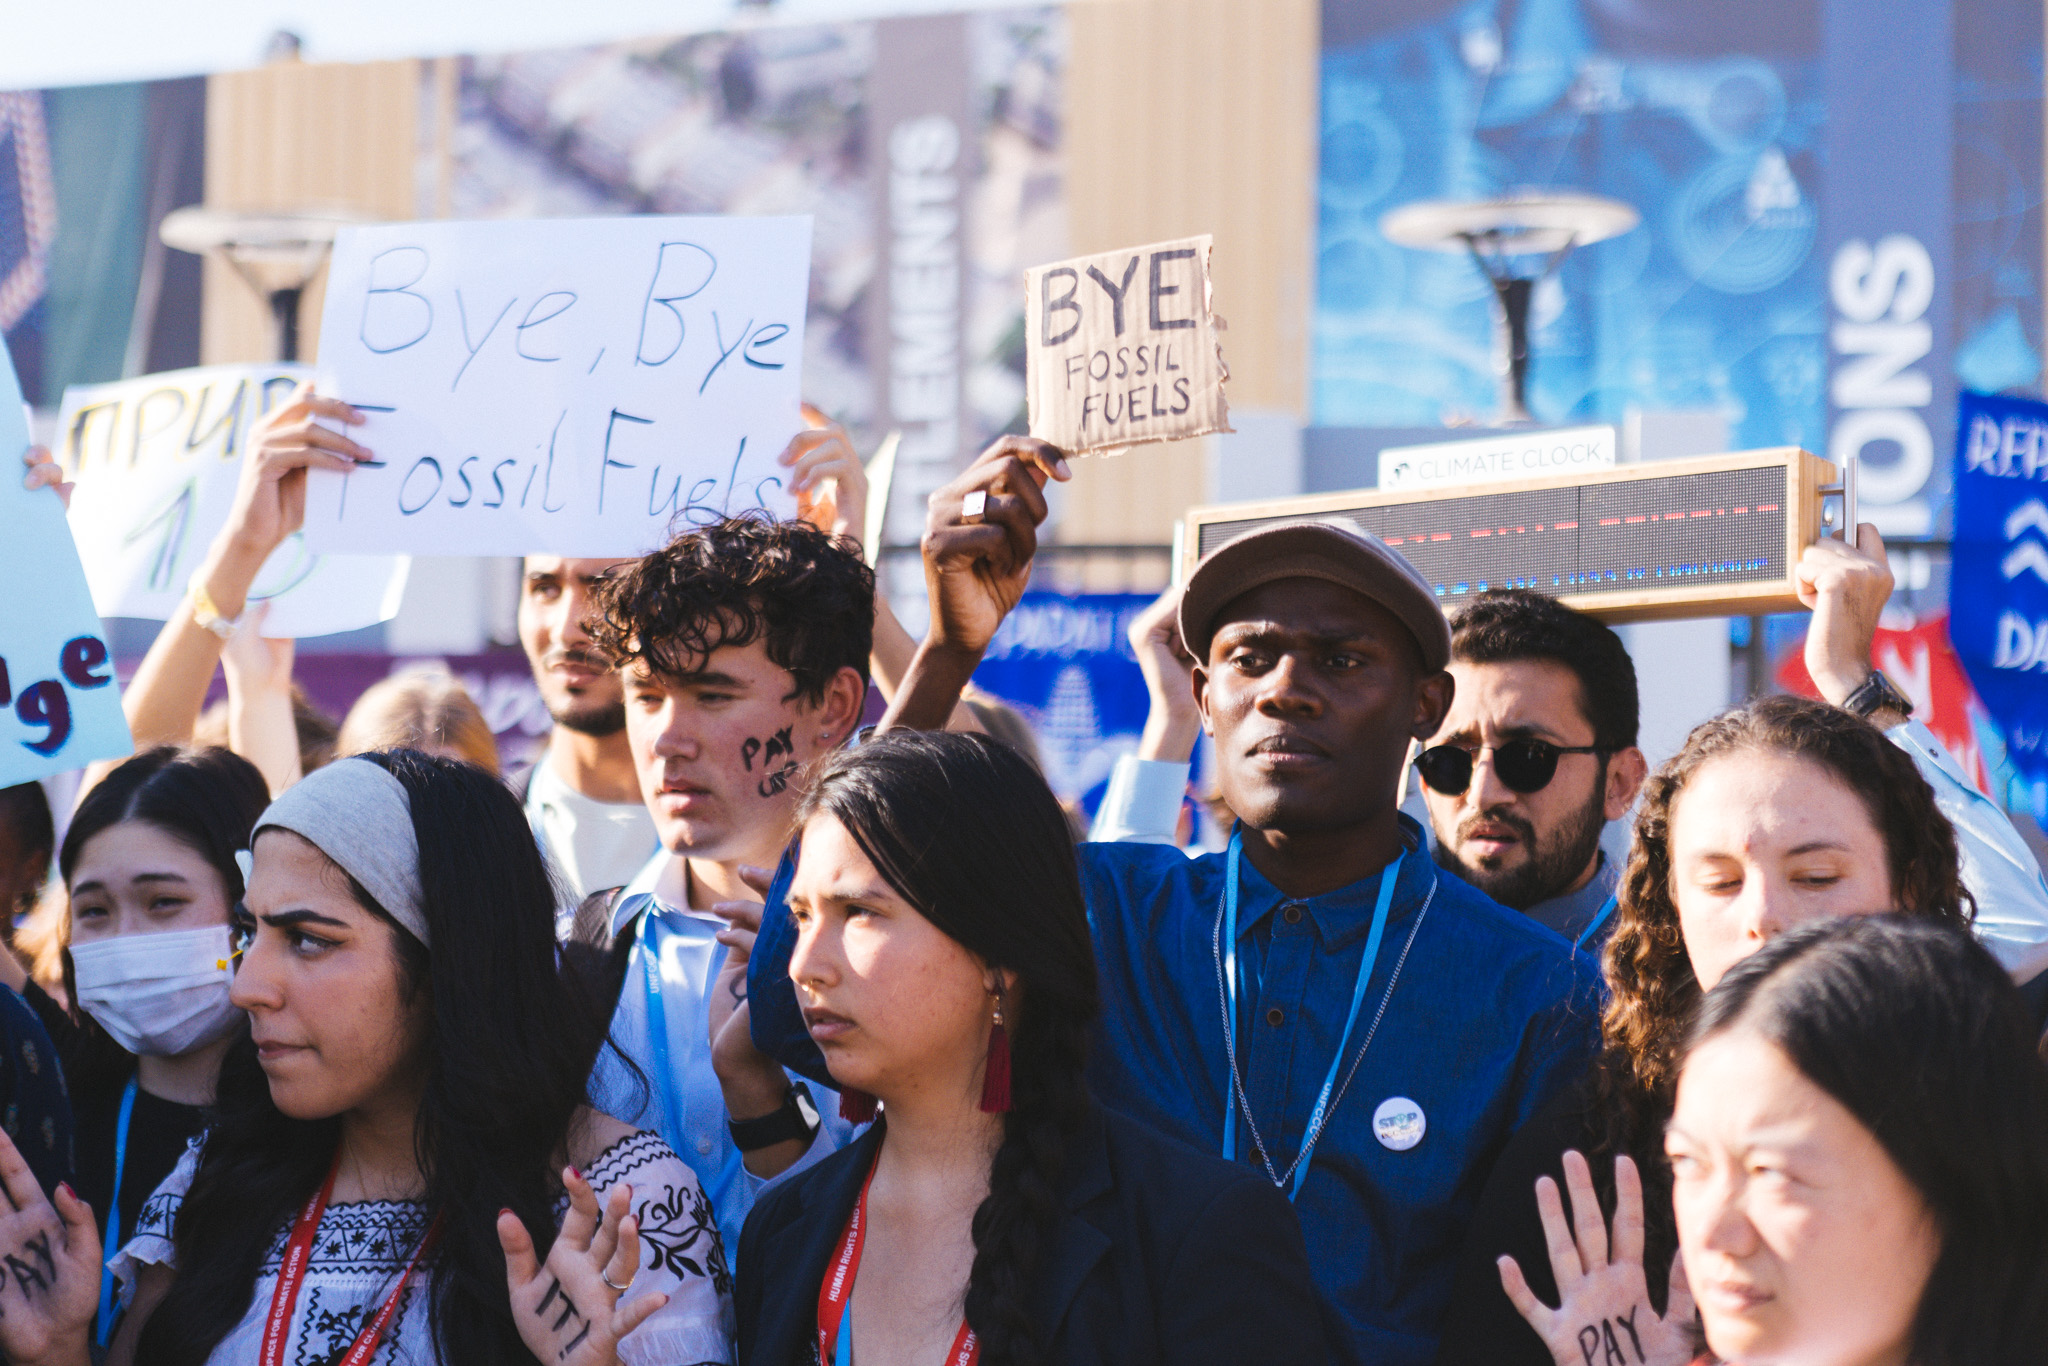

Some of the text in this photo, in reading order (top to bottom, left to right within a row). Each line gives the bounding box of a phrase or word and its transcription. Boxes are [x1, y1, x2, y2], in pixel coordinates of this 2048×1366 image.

[360, 241, 789, 394] Bye, Bye
[1042, 248, 1196, 347] BYE
[1065, 344, 1180, 390] FOSSIL
[1081, 378, 1191, 432] FUELS
[339, 404, 567, 522] Fossil
[1418, 443, 1601, 480] CLIMATE CLOCK
[742, 723, 794, 772] PAY
[828, 1207, 861, 1302] HUMAN RIGHTS AND
[265, 1246, 302, 1366] PACE FOR CLIMATE ACTION
[535, 1277, 591, 1360] IT!
[1578, 1304, 1646, 1366] PAY
[955, 1351, 970, 1366] SP
